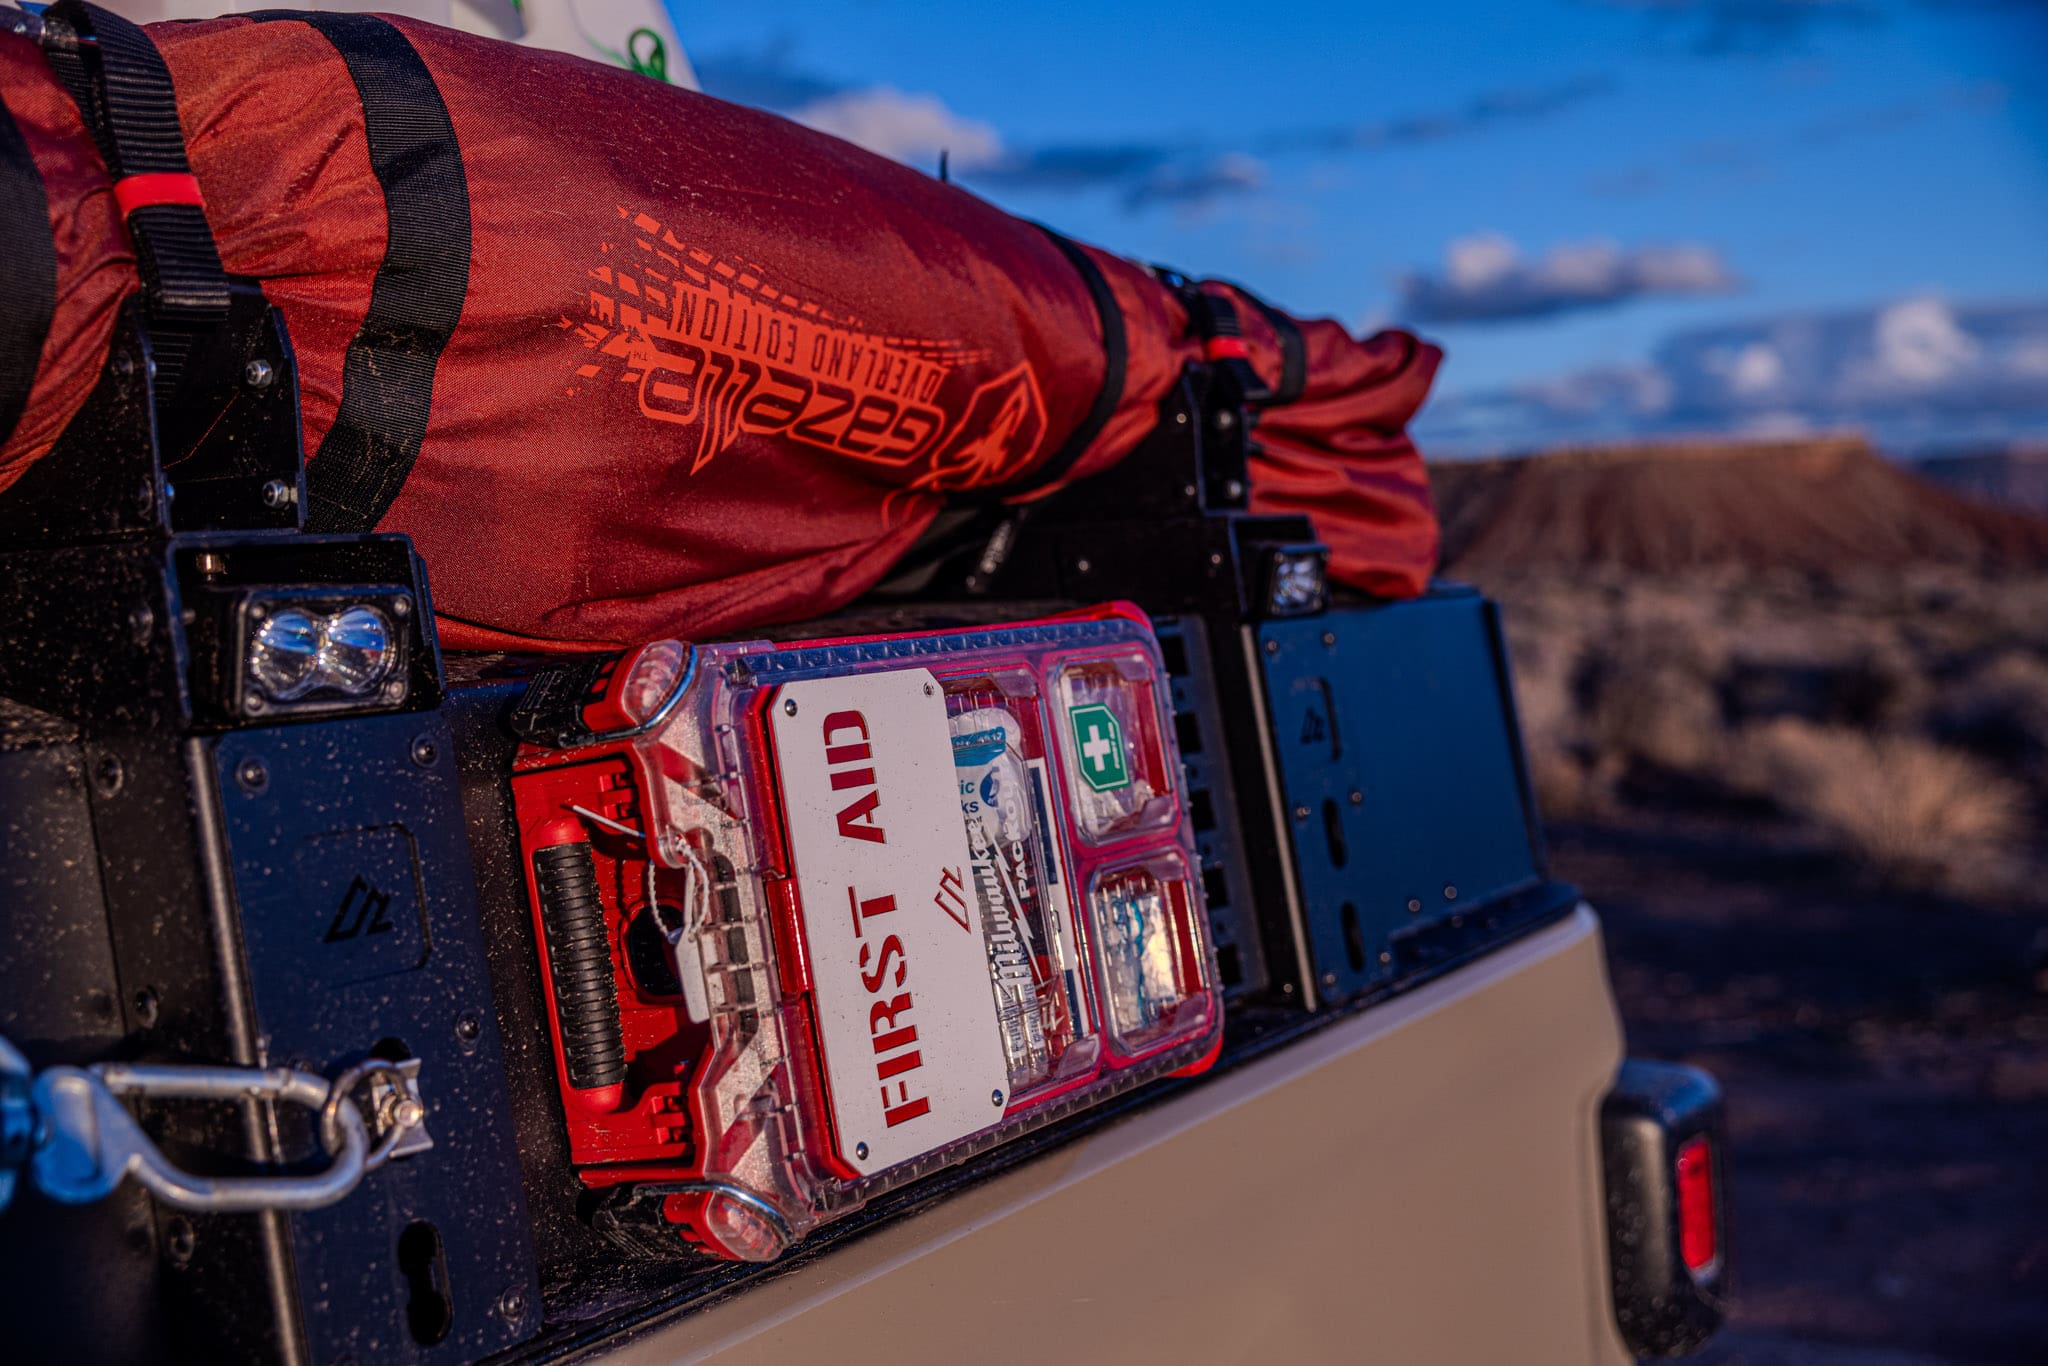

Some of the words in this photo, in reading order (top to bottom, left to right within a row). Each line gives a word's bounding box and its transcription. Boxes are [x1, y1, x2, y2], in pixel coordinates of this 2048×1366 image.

[673, 289, 796, 364] EDITION
[813, 333, 941, 404] OVERLAND
[824, 709, 887, 844] AID
[969, 820, 1031, 995] Milwaukee
[848, 886, 931, 1127] FIRST
